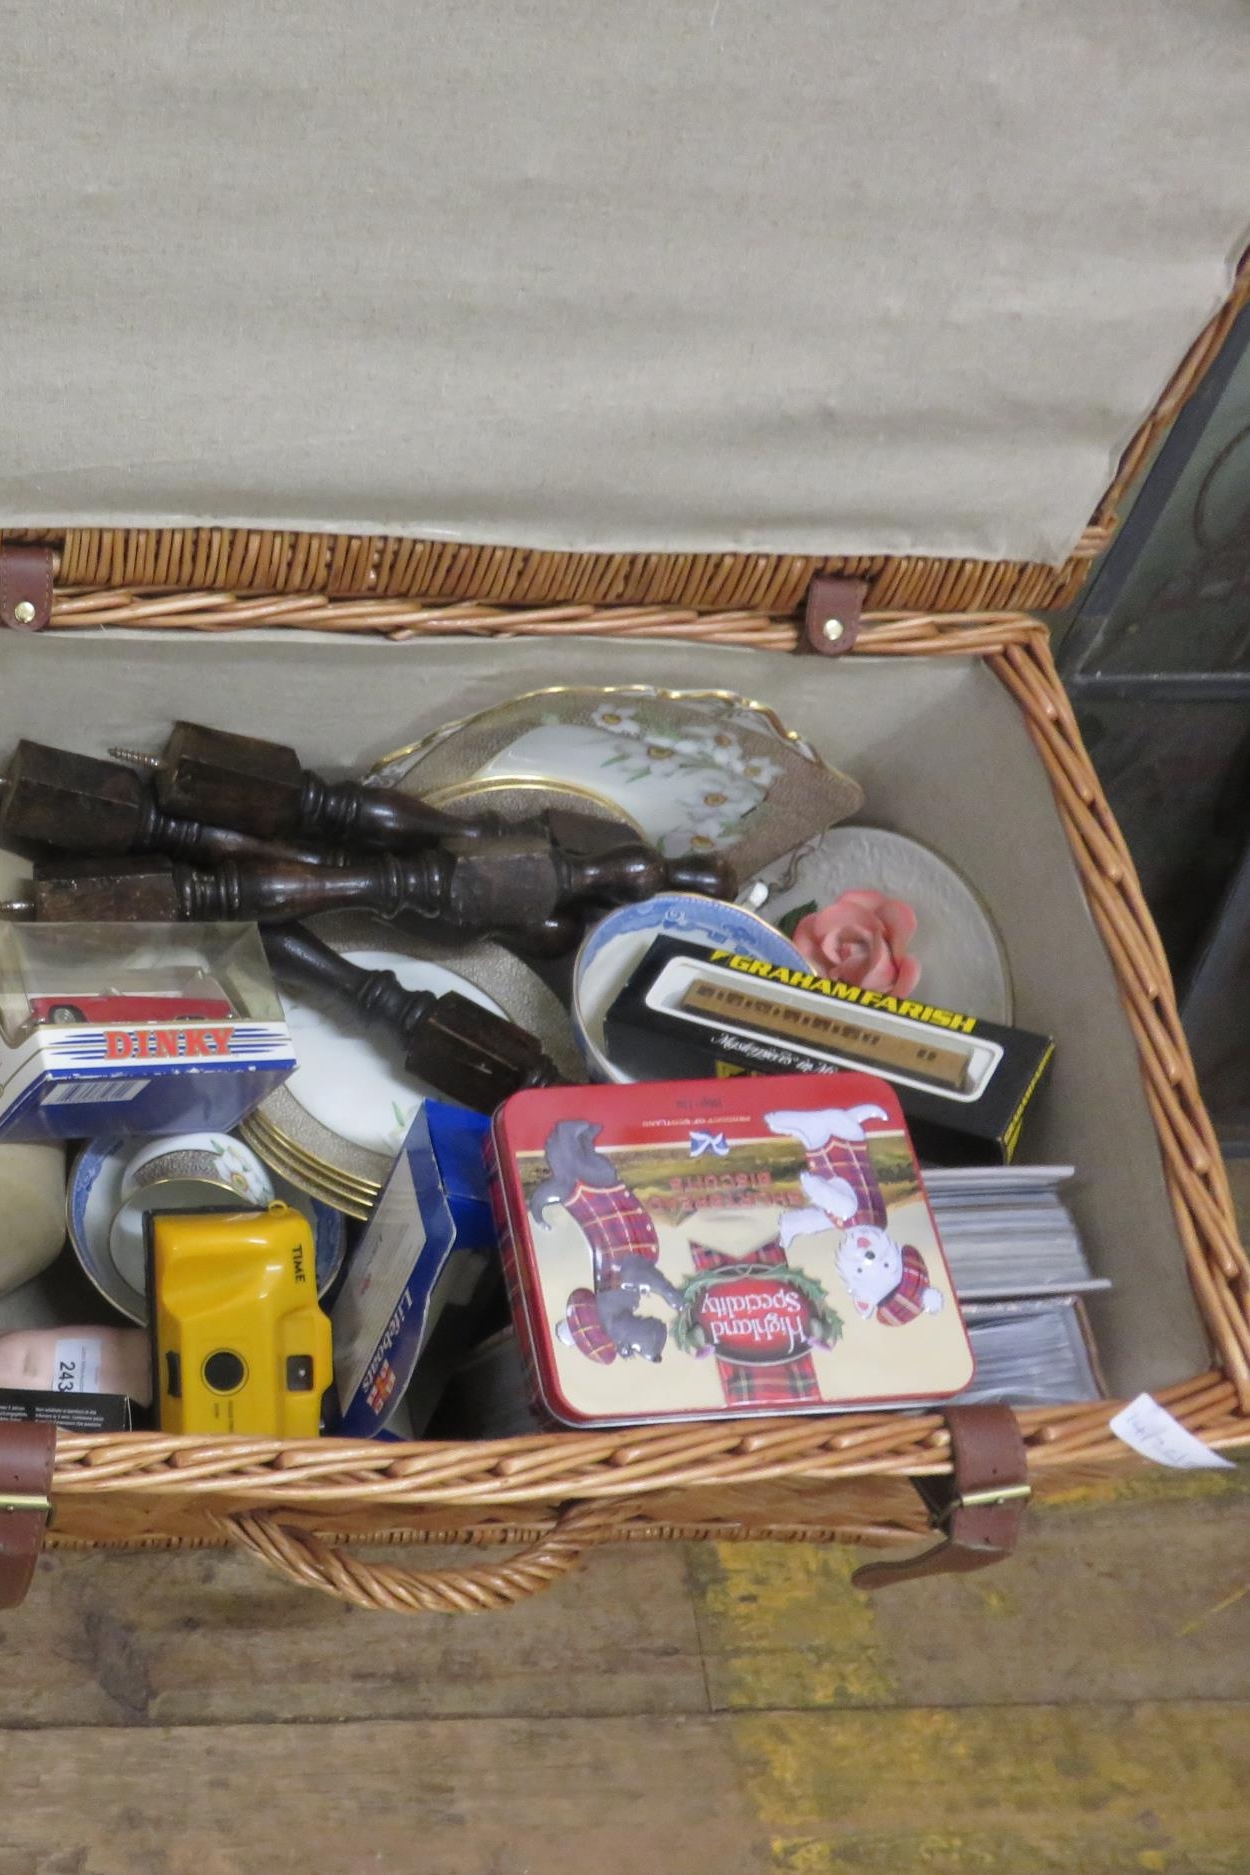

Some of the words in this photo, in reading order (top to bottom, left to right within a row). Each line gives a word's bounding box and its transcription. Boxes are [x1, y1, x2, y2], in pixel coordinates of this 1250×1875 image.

[728, 954, 861, 1001] GRAHAM
[860, 991, 977, 1034] FARISH
[103, 1027, 235, 1060] DINKY
[669, 1171, 772, 1191] BISCUITS
[293, 1244, 306, 1284] TIME
[701, 1288, 801, 1319] Speciality
[710, 1313, 808, 1354] Highland
